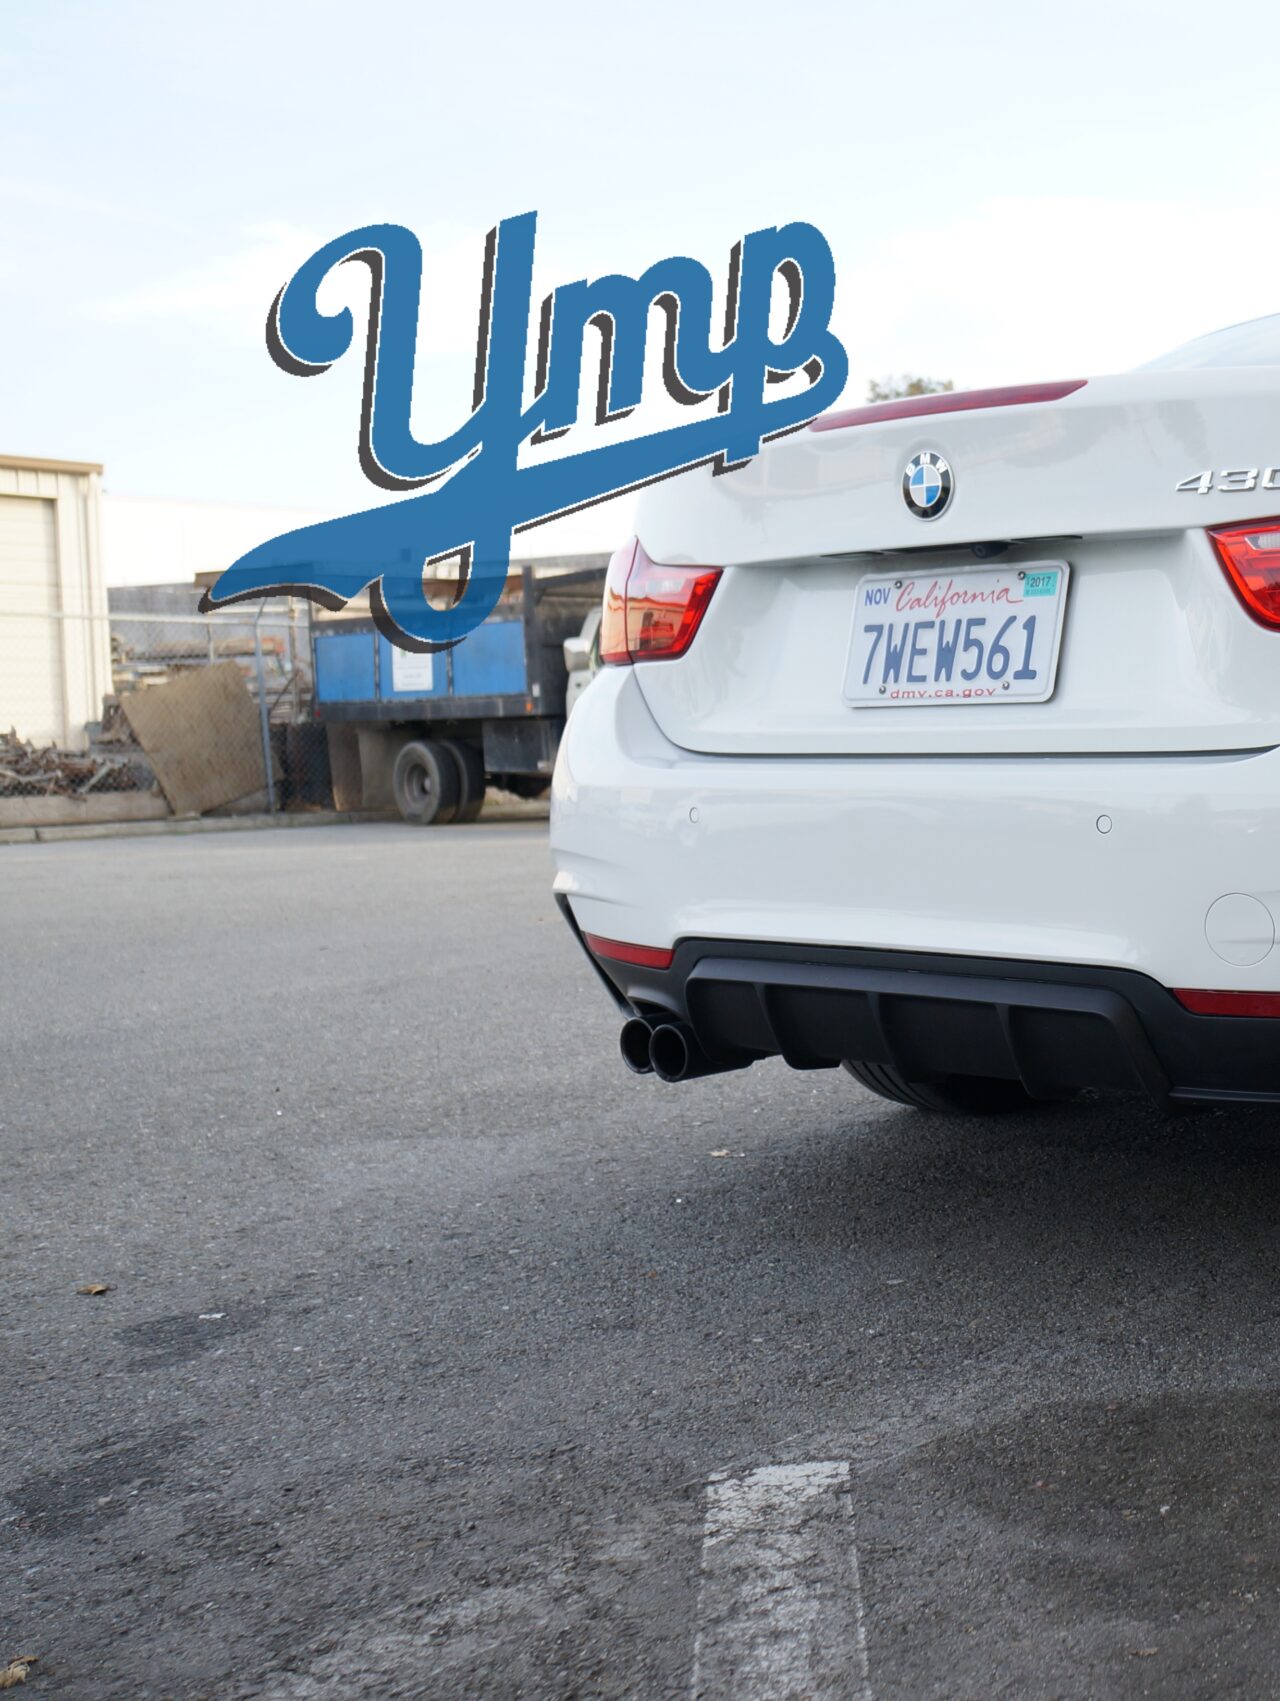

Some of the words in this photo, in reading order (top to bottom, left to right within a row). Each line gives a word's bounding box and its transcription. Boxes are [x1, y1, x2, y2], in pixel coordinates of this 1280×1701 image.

[905, 452, 949, 477] BMW
[1029, 575, 1052, 588] 2017
[864, 587, 891, 607] NOV
[895, 579, 1024, 619] California
[862, 615, 1037, 685] 7WEW561
[890, 687, 997, 700] dmv.ca.gov
